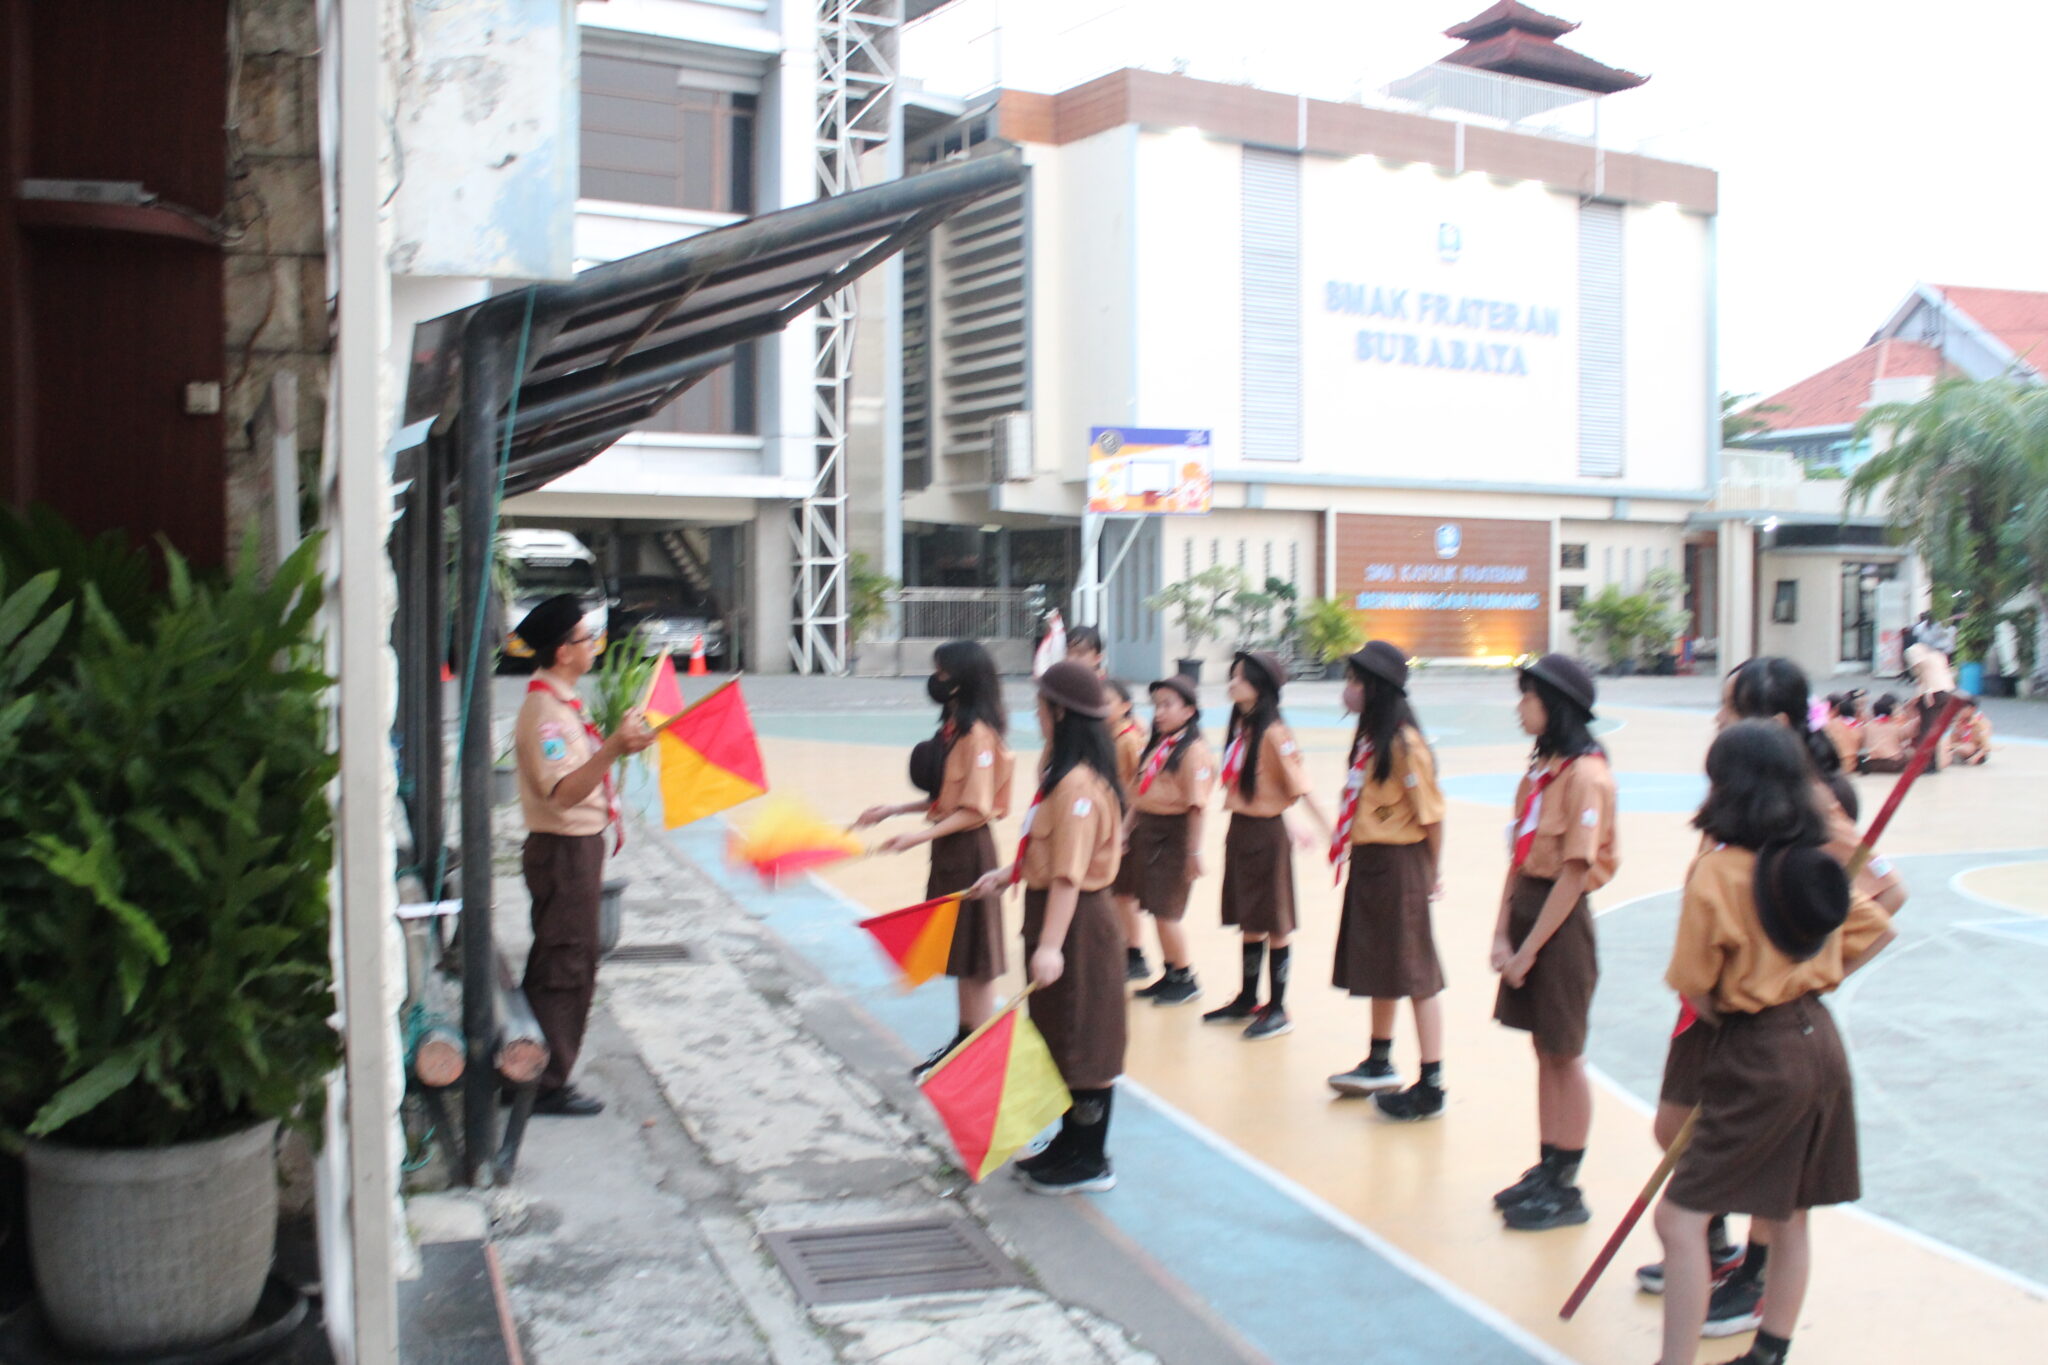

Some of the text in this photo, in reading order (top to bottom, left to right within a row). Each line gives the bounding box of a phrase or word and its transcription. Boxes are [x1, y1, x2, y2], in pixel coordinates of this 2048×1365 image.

[1325, 279, 1560, 337] SMAK FRATERAN
[1355, 329, 1529, 376] SURABAYA
